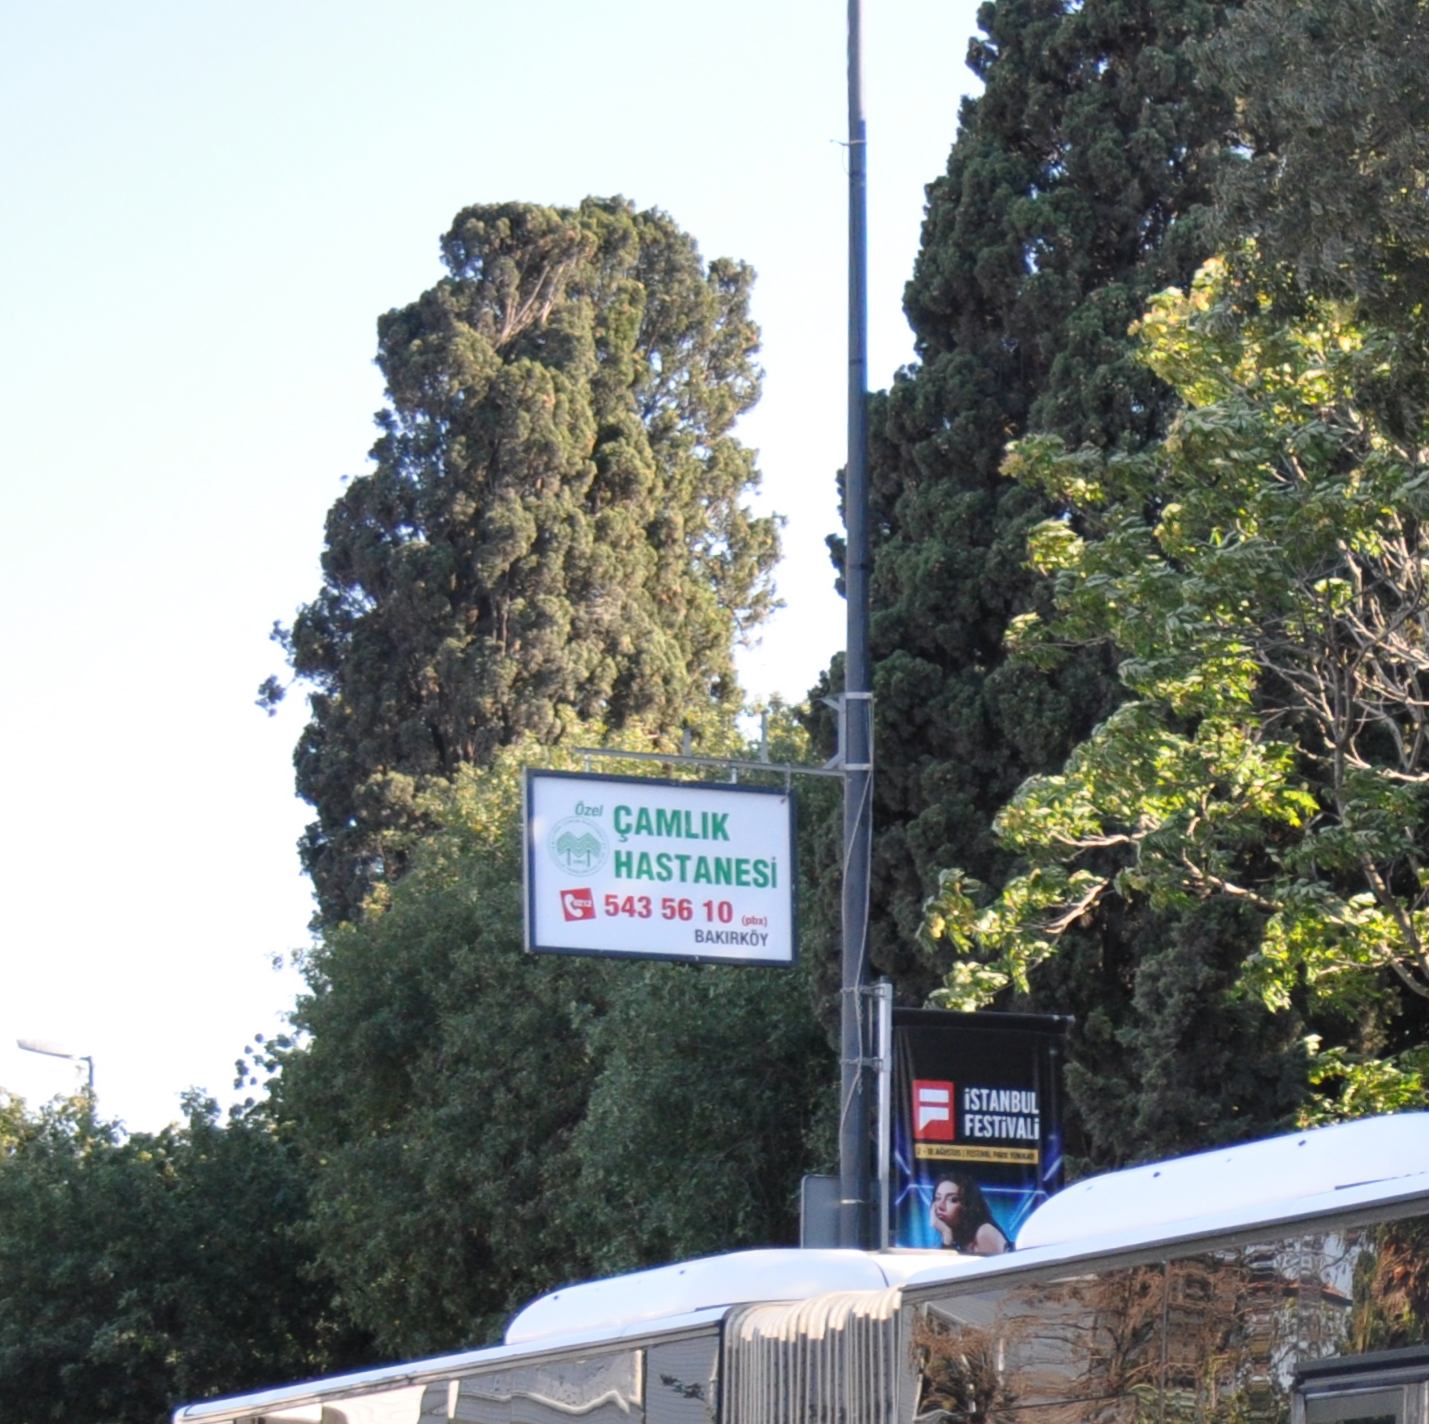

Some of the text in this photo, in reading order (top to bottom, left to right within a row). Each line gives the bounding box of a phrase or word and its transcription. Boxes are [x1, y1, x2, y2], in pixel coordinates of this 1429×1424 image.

[575, 801, 603, 817] Özel
[613, 805, 730, 842] ÇAMLIK
[614, 850, 777, 888] HASTANESİ
[604, 894, 652, 919] 543
[661, 898, 692, 921] 56
[703, 900, 733, 923] 10
[694, 927, 768, 947] BAKIRKÖY
[964, 1088, 1039, 1114] İSTANBUL
[964, 1114, 1040, 1140] FESTİVALİ
